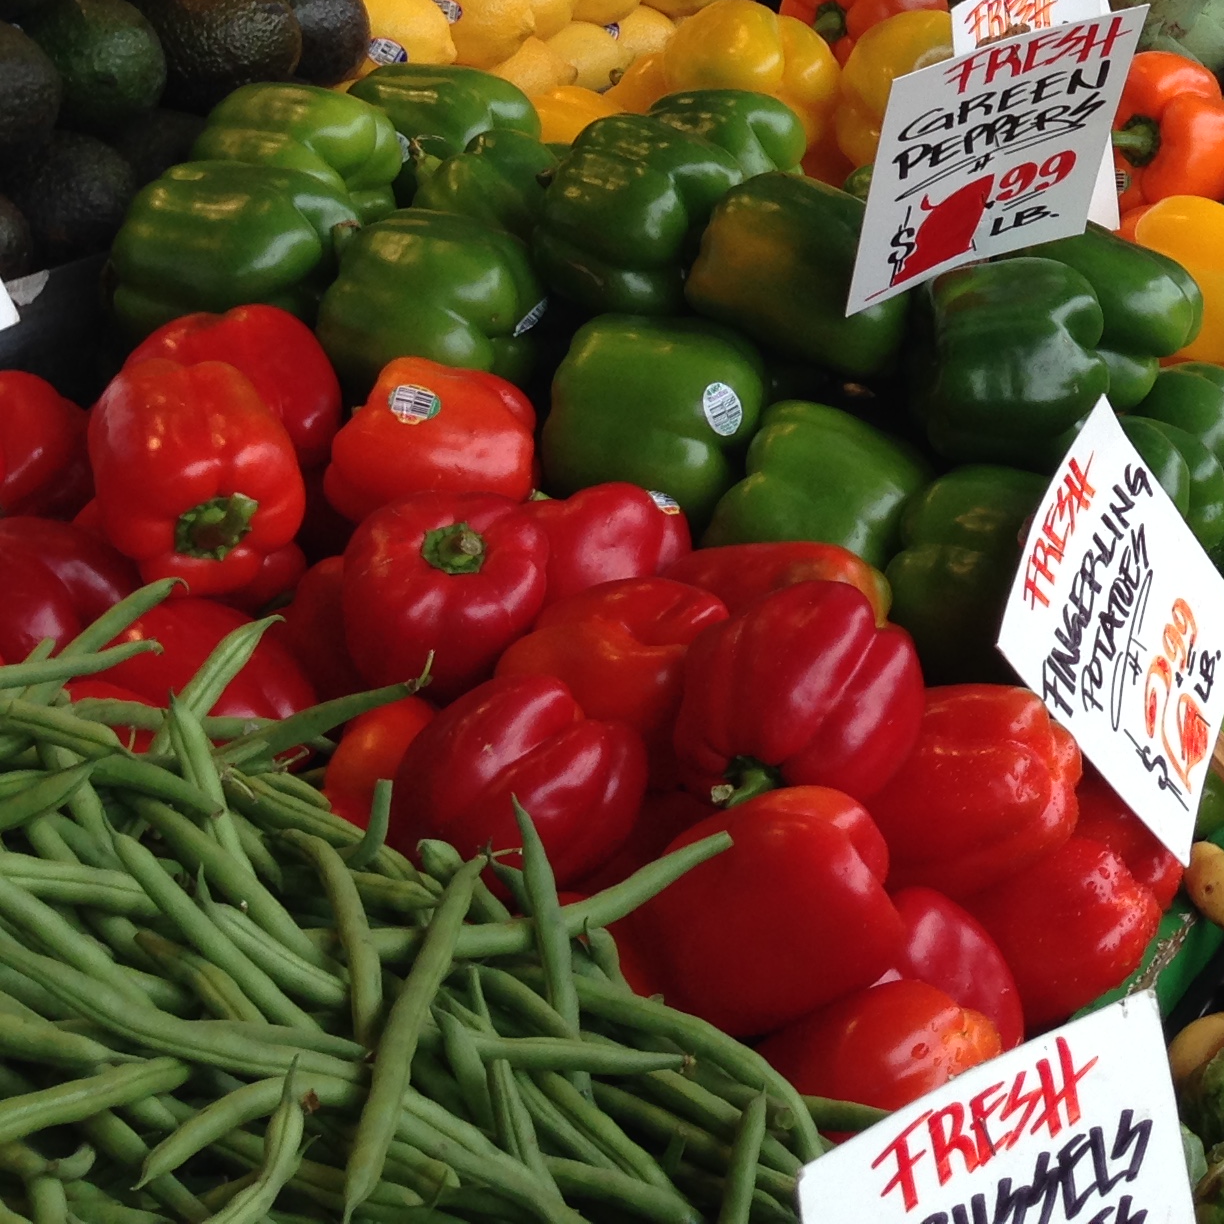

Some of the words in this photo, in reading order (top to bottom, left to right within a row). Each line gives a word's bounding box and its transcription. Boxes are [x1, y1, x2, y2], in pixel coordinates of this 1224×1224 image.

[898, 60, 1110, 141] GREEN
[944, 17, 1132, 95] FRESH
[892, 92, 1106, 179] PEPPERS
[990, 205, 1060, 237] LB.
[1023, 451, 1096, 611] FRESH
[1041, 464, 1153, 717] FINGERLING
[1082, 523, 1149, 712] POTATOES
[871, 1037, 1099, 1213] FRESH
